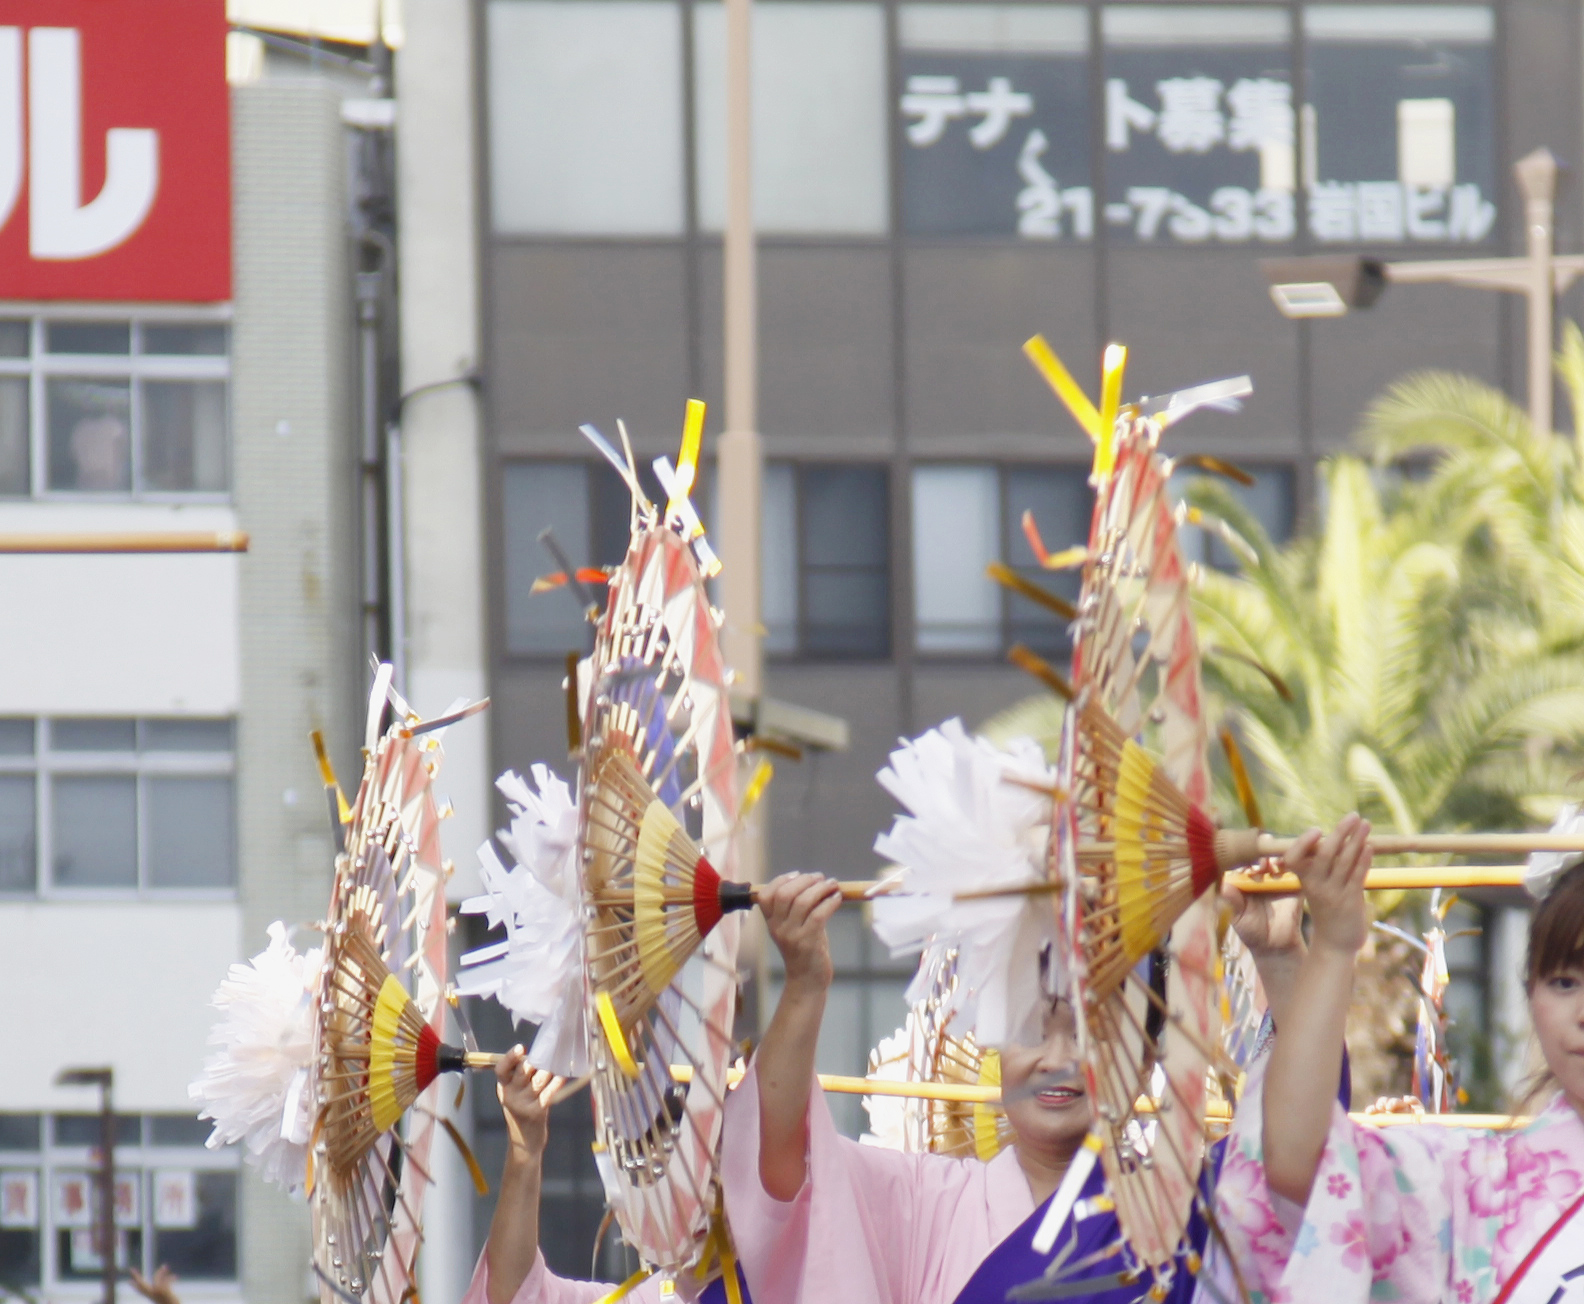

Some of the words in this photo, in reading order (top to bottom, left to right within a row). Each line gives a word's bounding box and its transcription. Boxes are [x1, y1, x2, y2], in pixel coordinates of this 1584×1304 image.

[900, 75, 1296, 153] テナト募集
